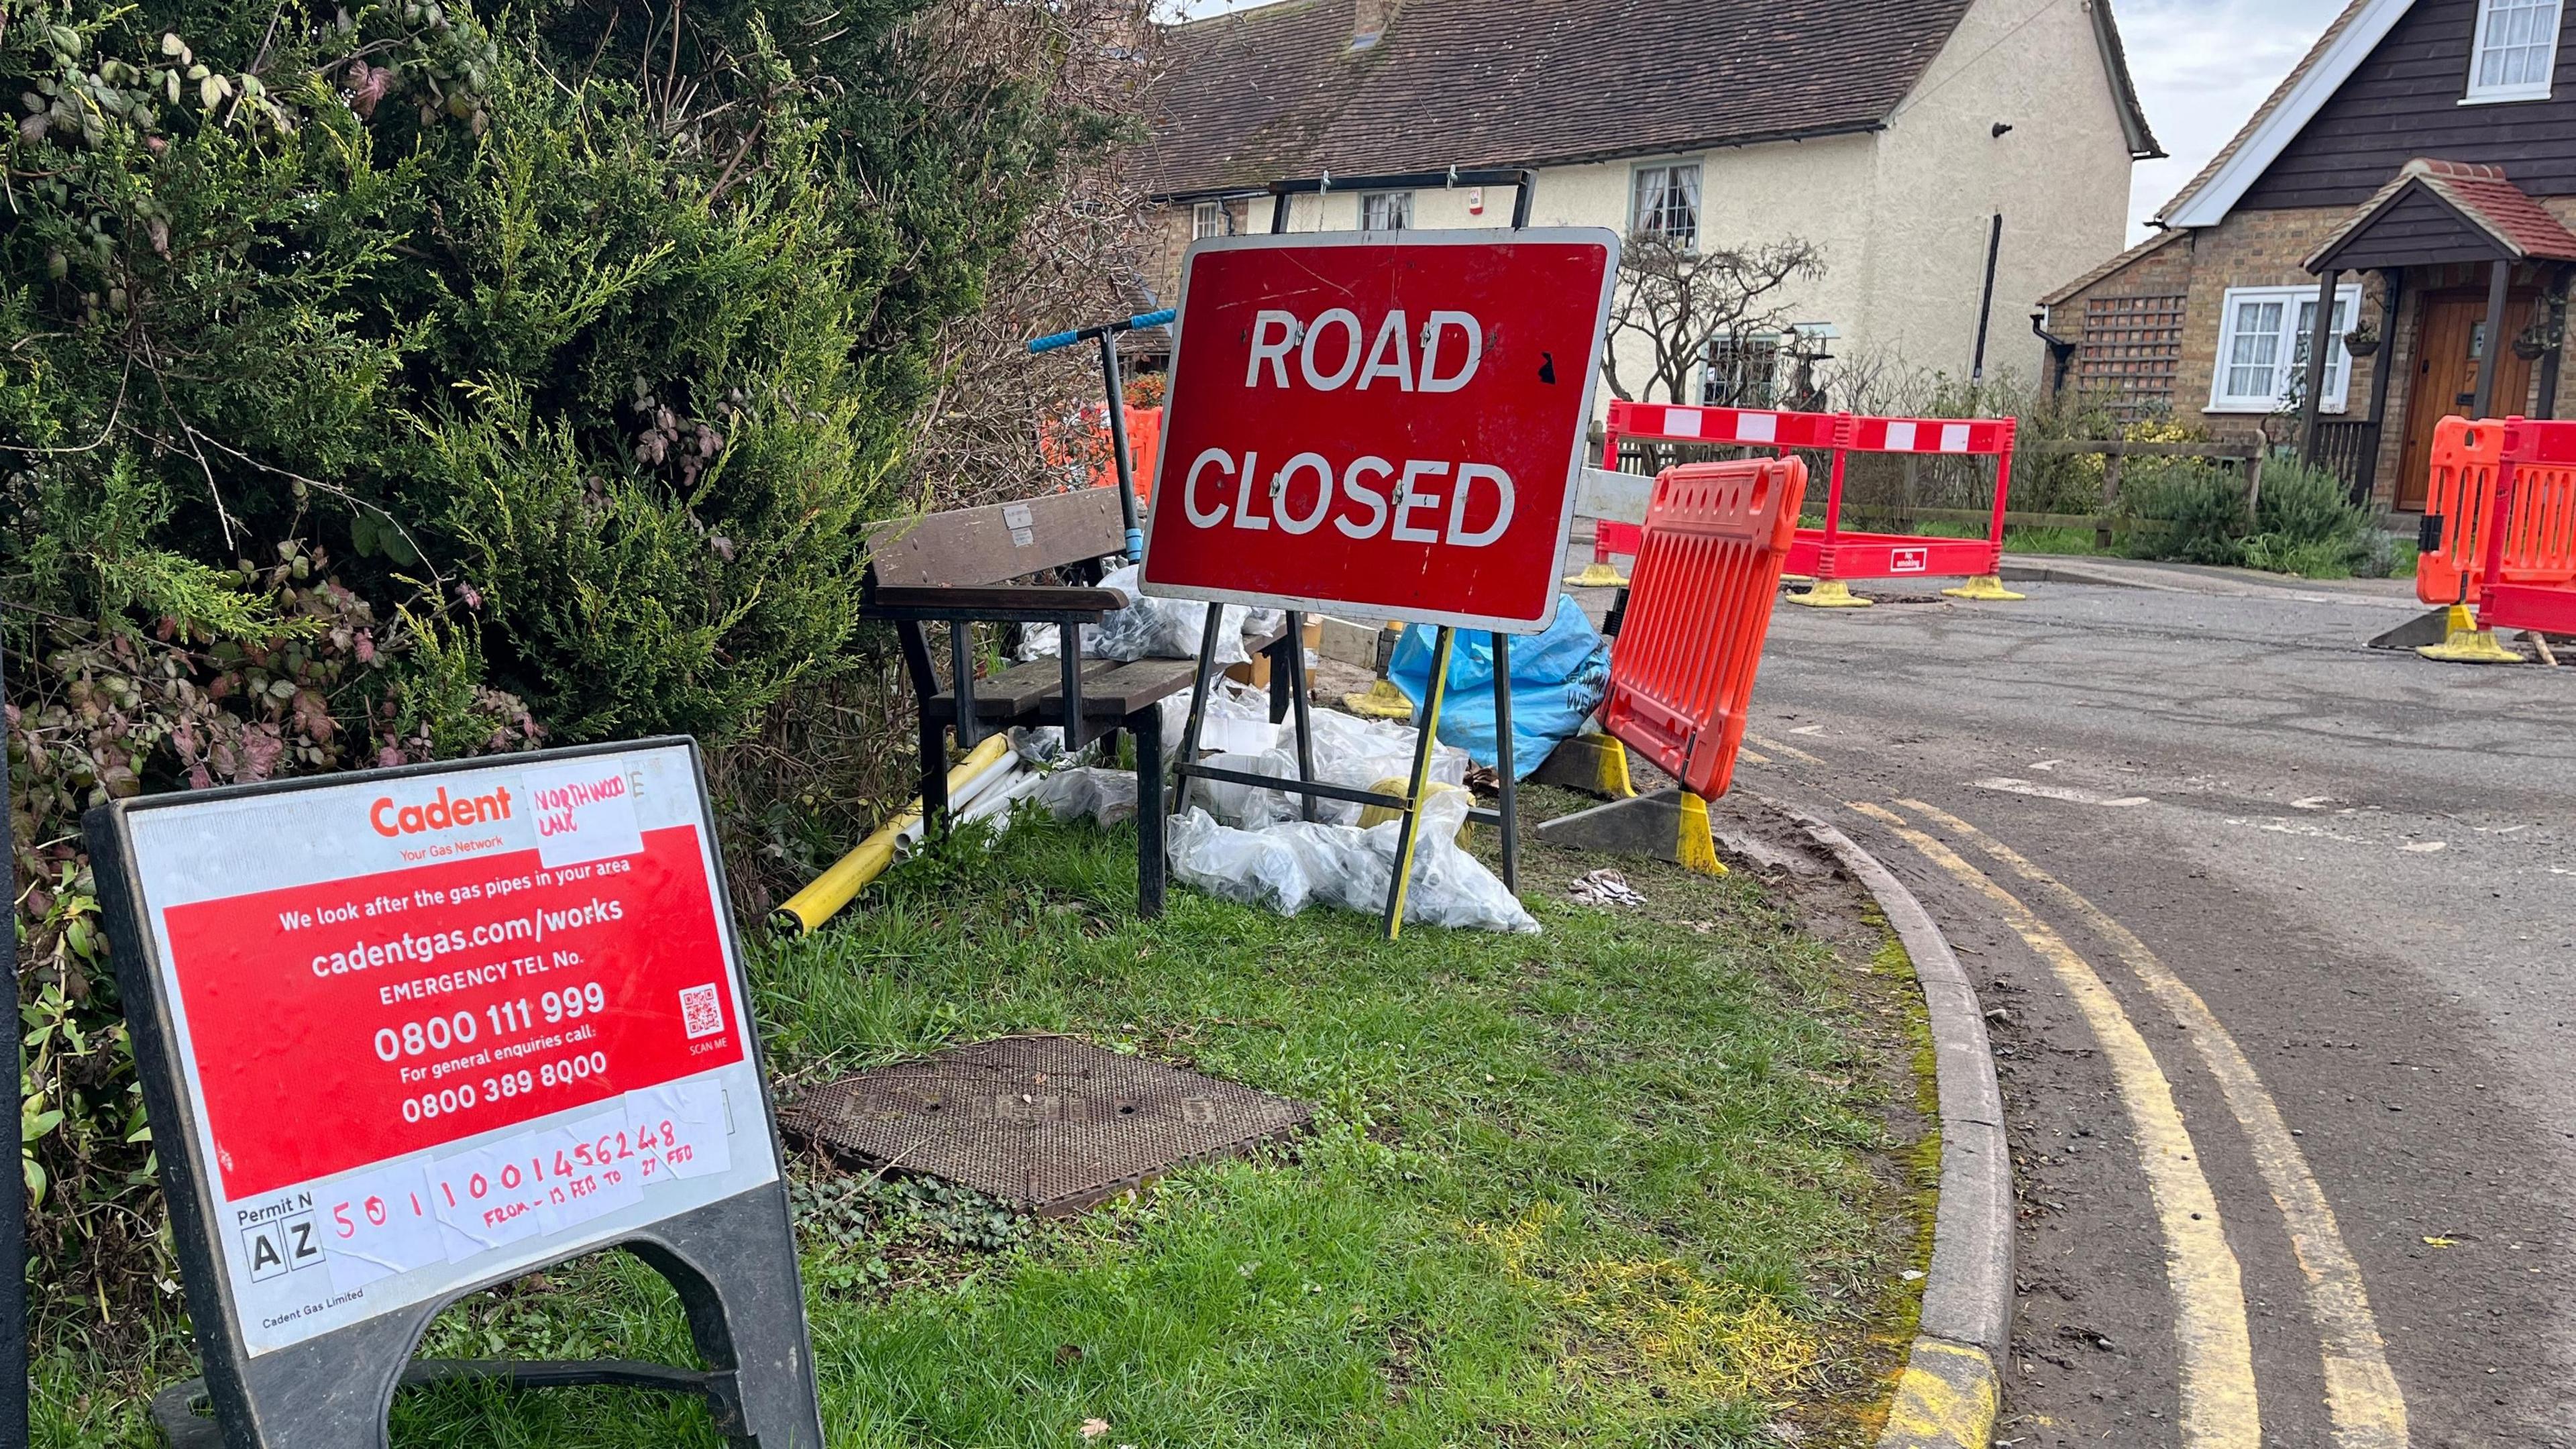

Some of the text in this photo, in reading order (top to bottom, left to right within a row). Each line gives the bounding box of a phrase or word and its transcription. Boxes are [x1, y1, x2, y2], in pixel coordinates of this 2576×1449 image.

[1245, 308, 1483, 392] ROAD
[1184, 447, 1515, 547] CLOSED
[368, 786, 513, 837] Cadent
[399, 836, 503, 863] Your Gas Network
[279, 859, 631, 931] We look after the gas pipes in your area
[311, 896, 623, 977] cadentgas.com/works
[379, 949, 584, 1006] EMERGENCY TEL No.
[374, 981, 604, 1063] 0800 111 999
[690, 1036, 728, 1056] SCAN ME
[400, 1024, 596, 1085] For general enquiries call:
[402, 1051, 606, 1124] 0800 389 8000
[237, 1199, 293, 1226] Permit
[482, 1200, 530, 1229] FROM
[570, 1173, 598, 1199] FEB
[603, 1169, 622, 1186] TO
[642, 1157, 656, 1177] 27
[667, 1143, 693, 1165] FEB
[254, 1222, 317, 1271] A Z
[262, 1288, 364, 1330] Cadent Gas Limited
